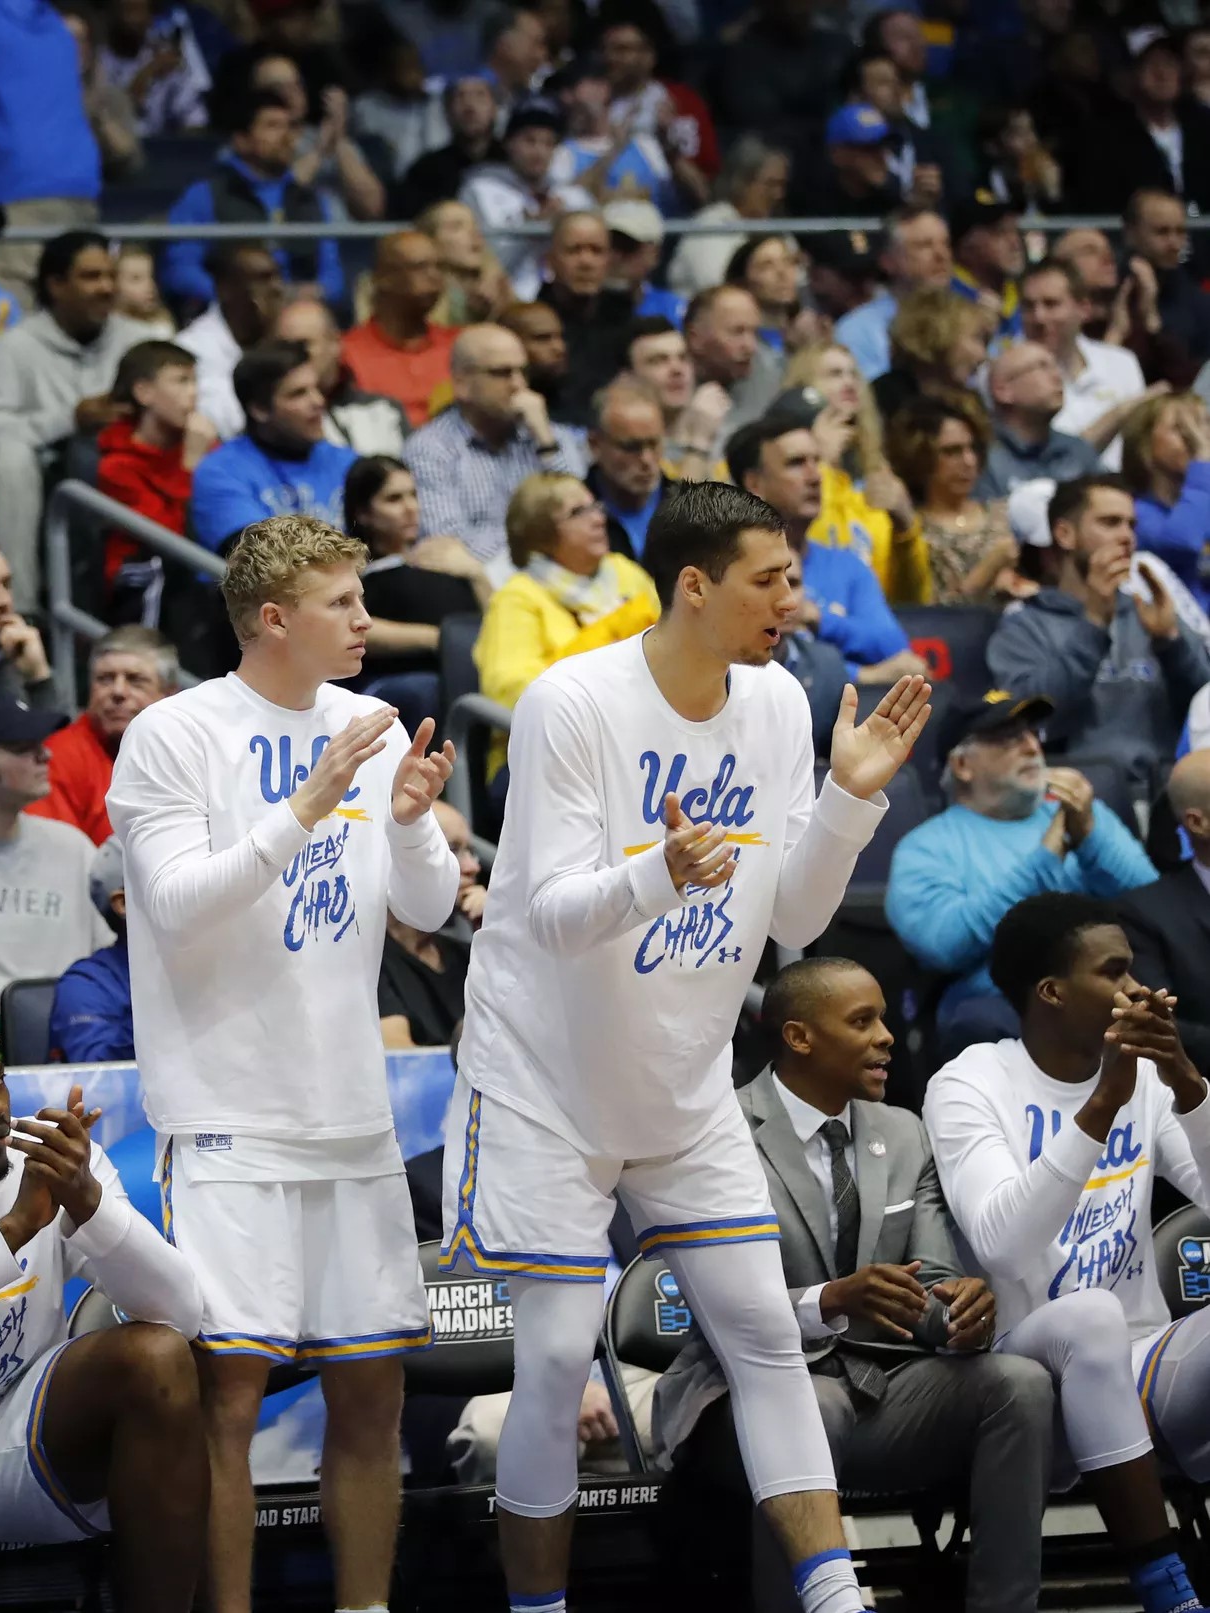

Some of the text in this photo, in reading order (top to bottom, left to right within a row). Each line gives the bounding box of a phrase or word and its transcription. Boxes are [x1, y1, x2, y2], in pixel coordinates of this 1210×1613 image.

[640, 750, 755, 828] Ucla
[633, 886, 734, 974] CHAOS
[1047, 1209, 1138, 1301] CHAOS
[432, 1304, 515, 1334] MADNES
[282, 1506, 320, 1526] STAR
[621, 1485, 659, 1505] HERE
